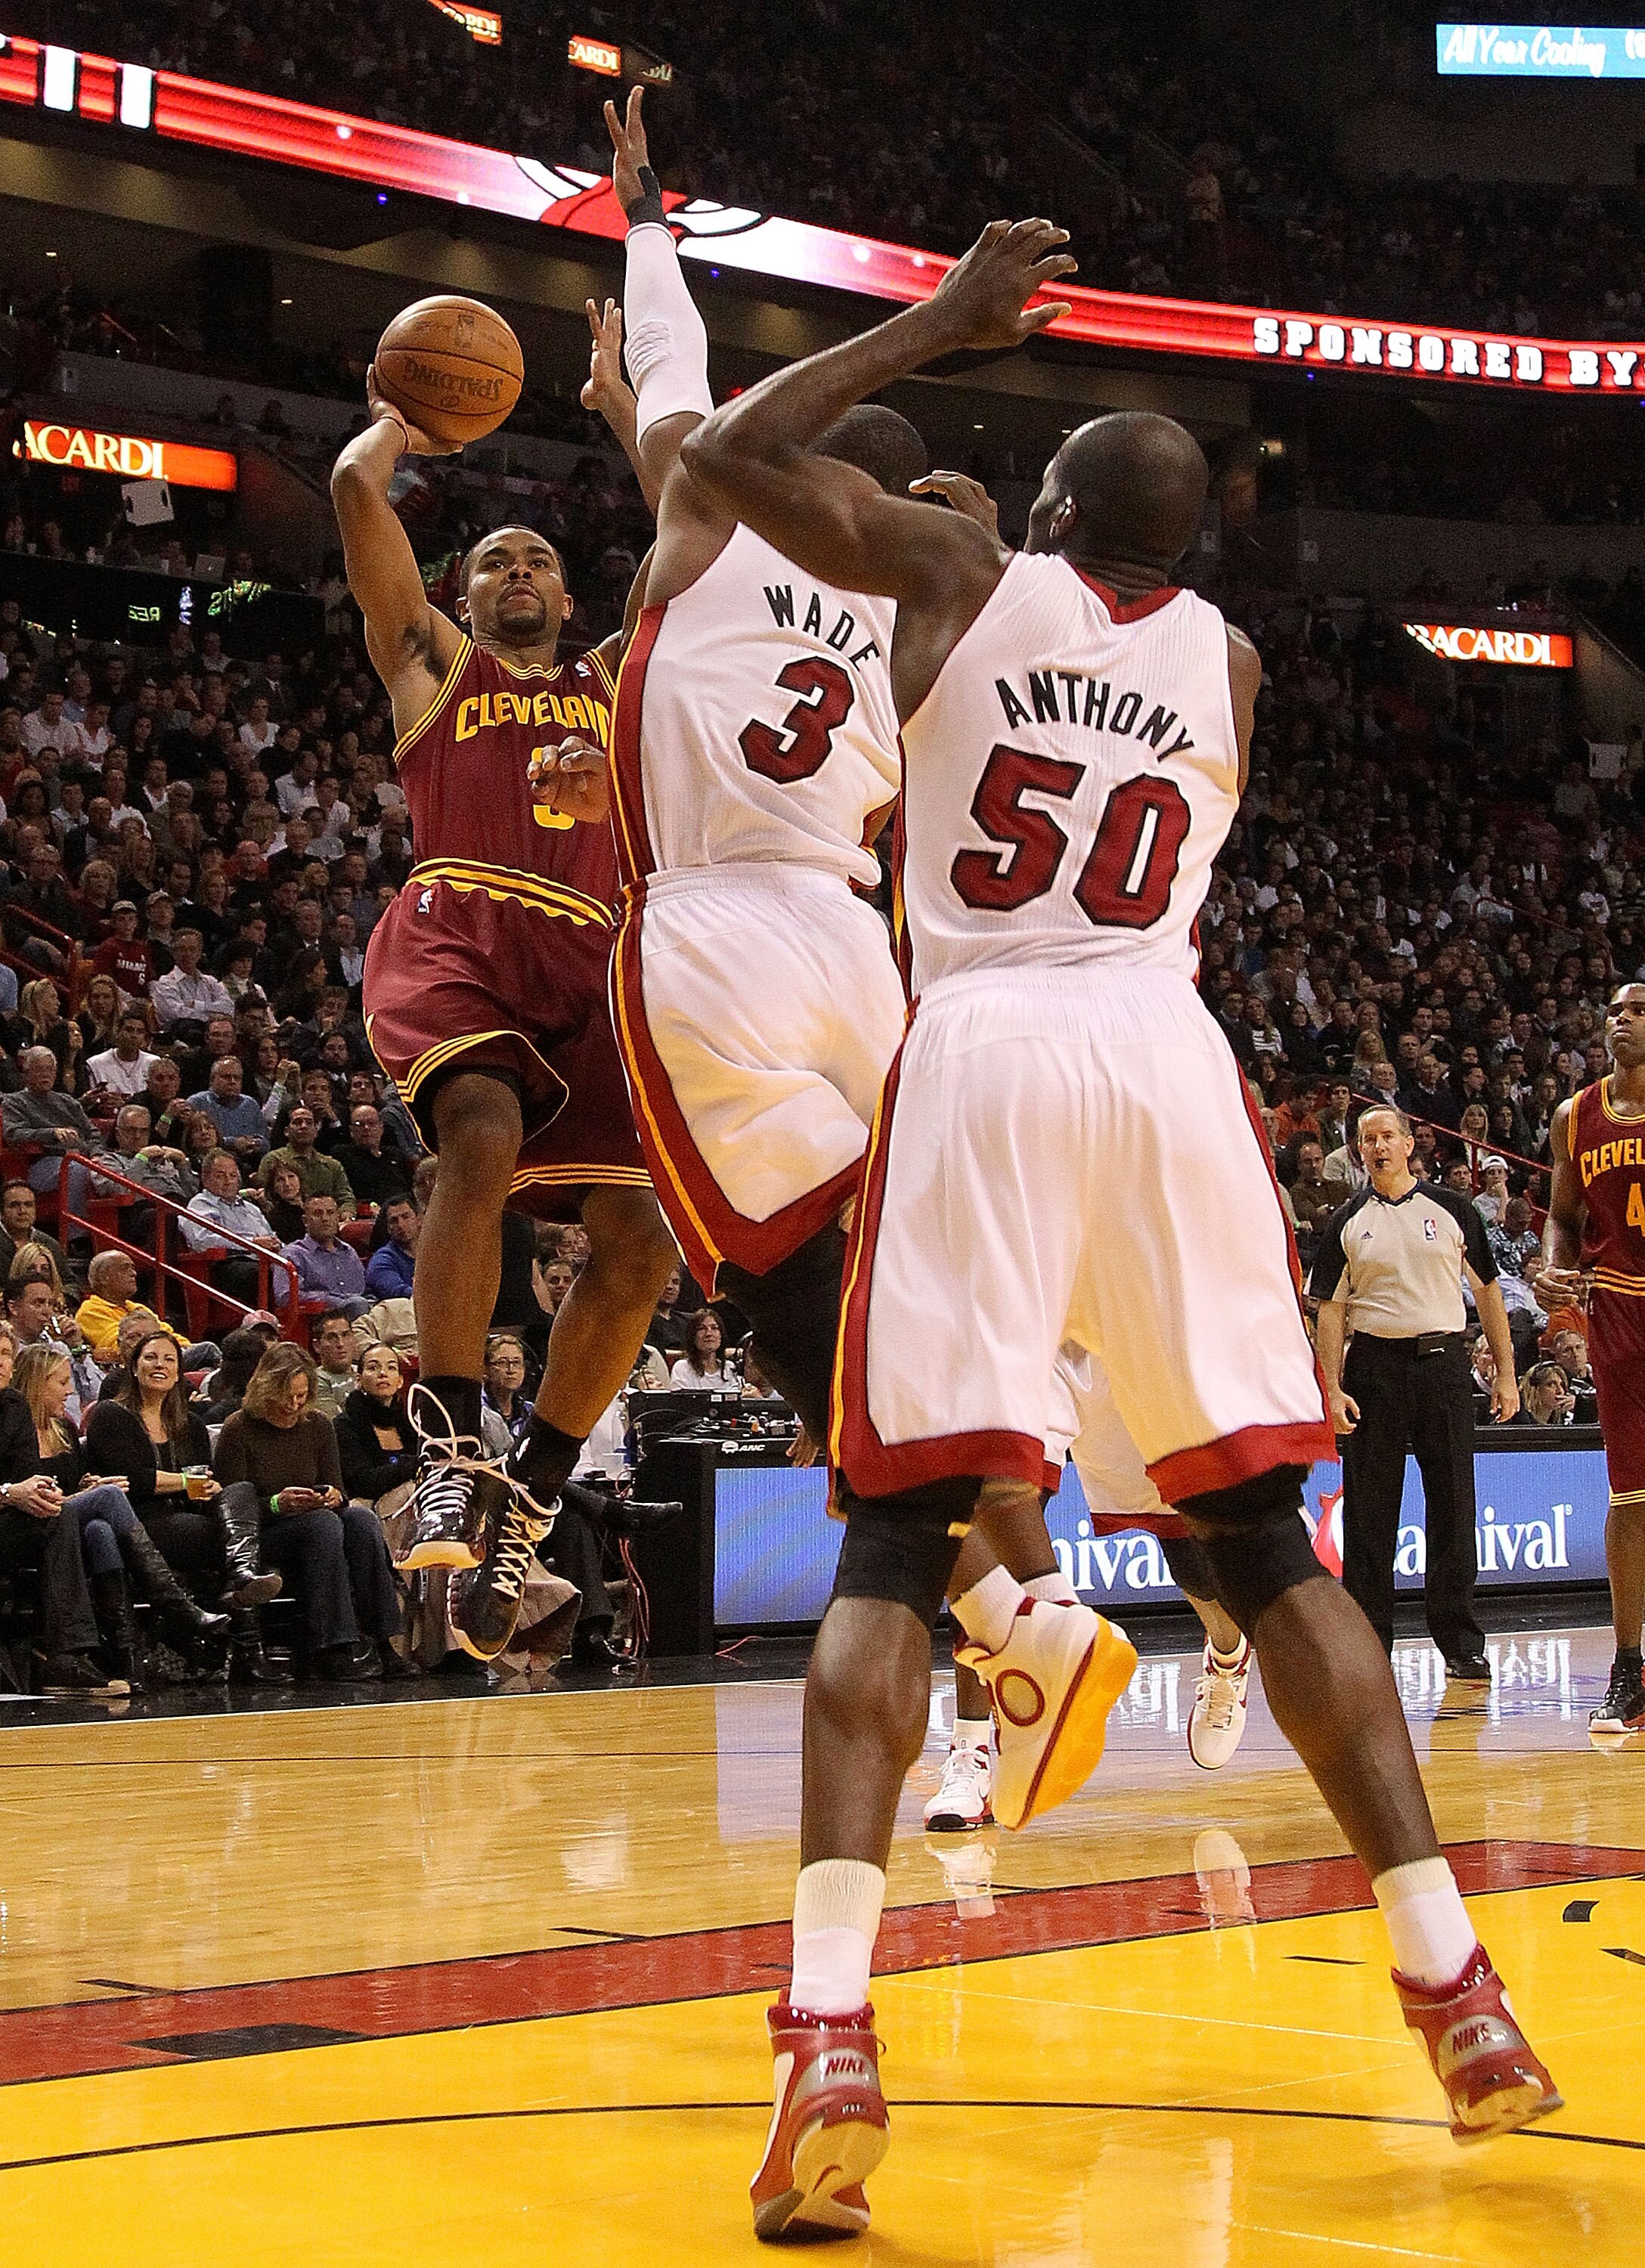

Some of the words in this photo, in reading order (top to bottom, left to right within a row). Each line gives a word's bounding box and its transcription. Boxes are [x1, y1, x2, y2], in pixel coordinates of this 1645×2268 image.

[1530, 27, 1606, 78] Cooling
[1253, 317, 1543, 382] SPONSORED
[1569, 350, 1637, 386] BY
[12, 420, 164, 481] ACARDI
[764, 585, 880, 671] WADE
[738, 655, 854, 785] 3
[995, 670, 1194, 762] ANTHONY
[950, 743, 1191, 931] 50
